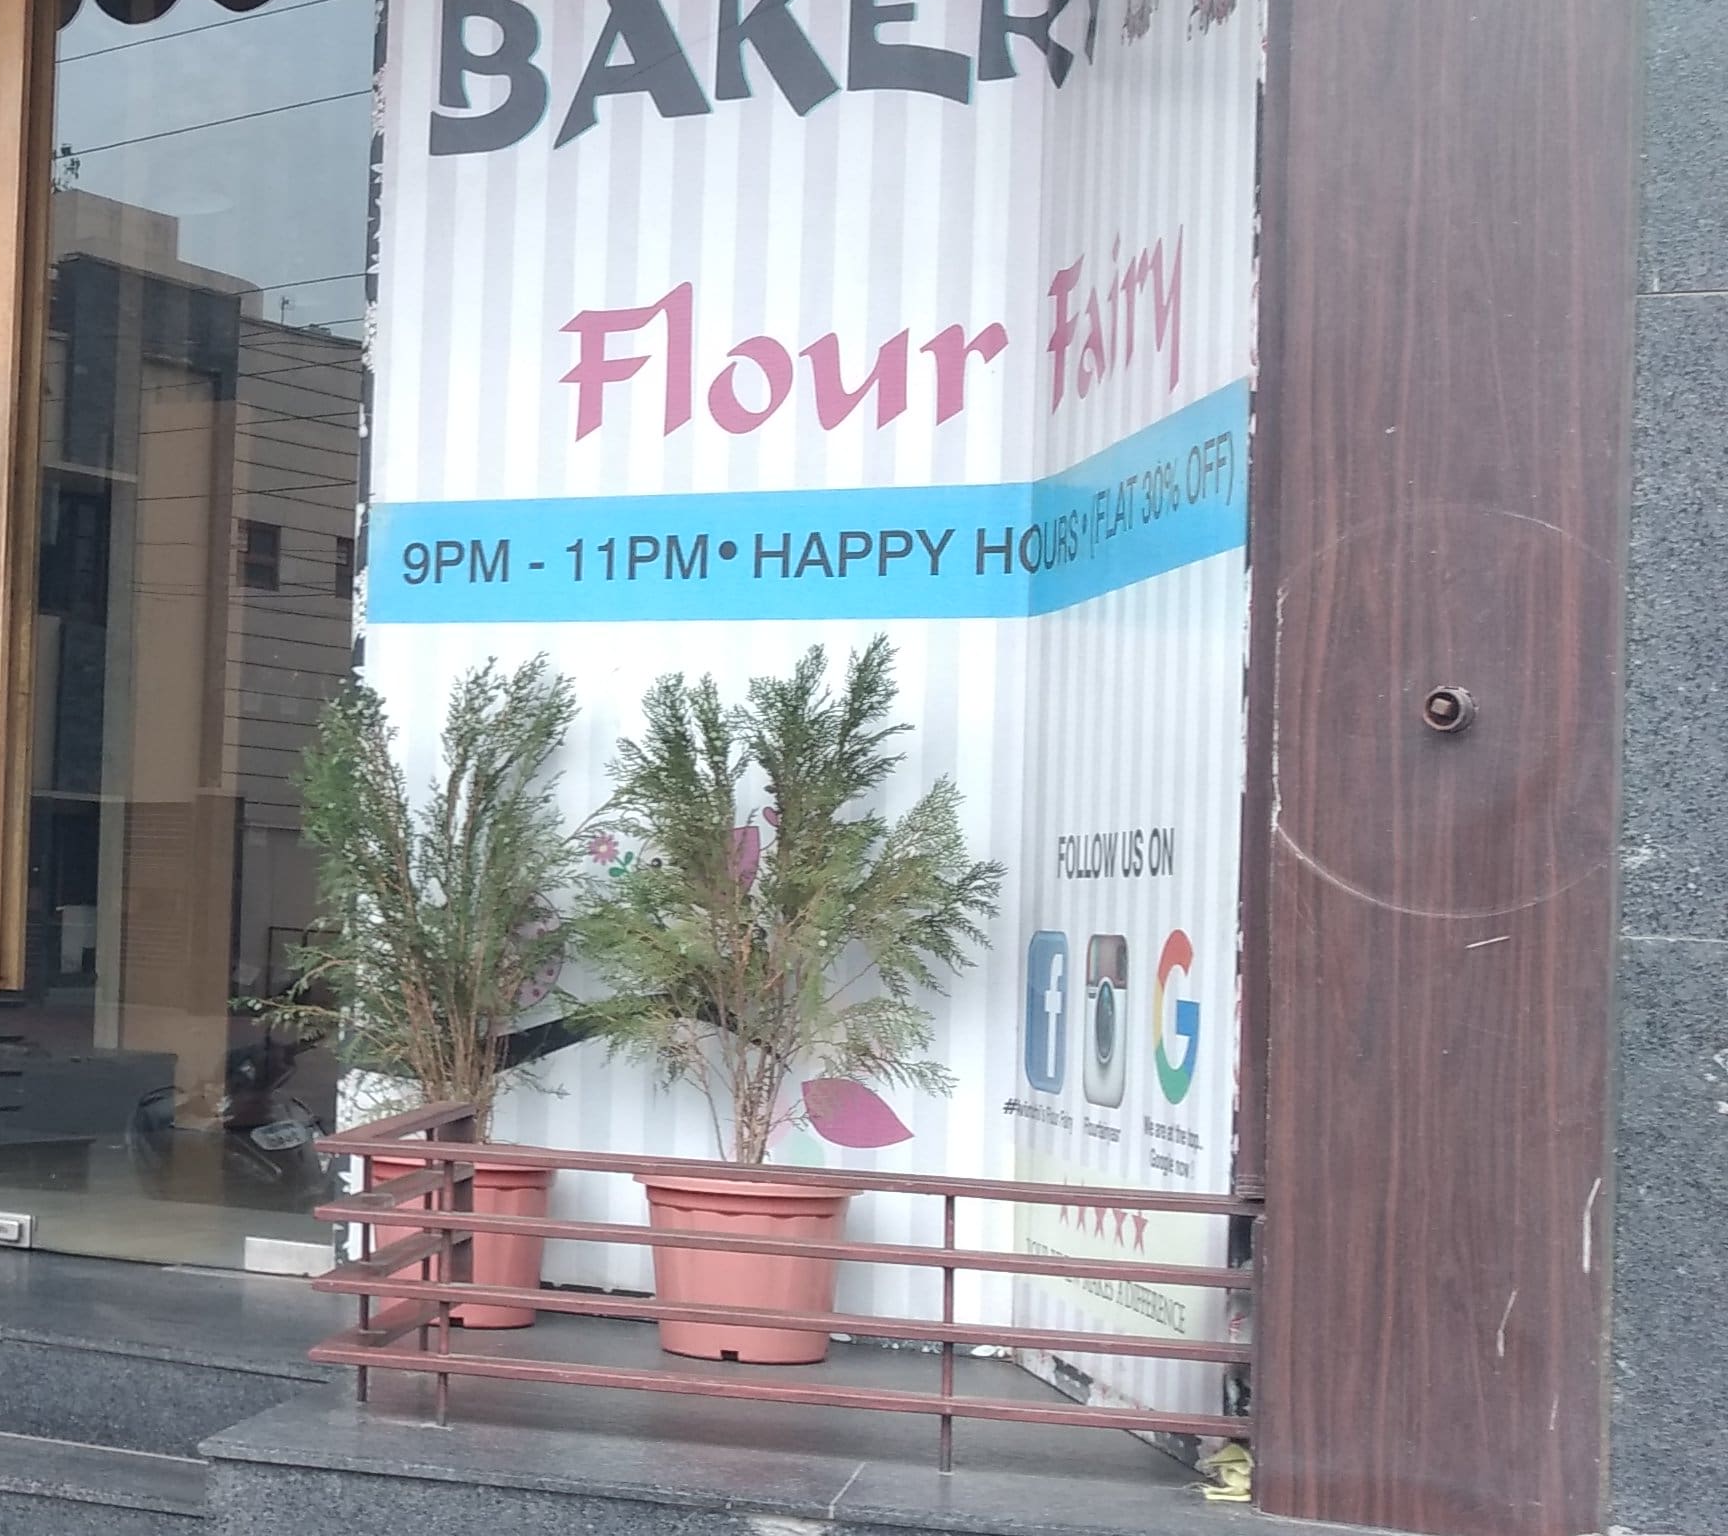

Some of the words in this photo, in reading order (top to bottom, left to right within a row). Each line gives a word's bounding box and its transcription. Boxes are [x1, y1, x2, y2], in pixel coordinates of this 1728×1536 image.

[559, 281, 1010, 441] Flour
[1047, 223, 1184, 415] Fairy
[402, 539, 510, 585] 9PM
[565, 533, 709, 582] 11PM
[752, 528, 956, 579] HAPPY
[975, 509, 1078, 574] HOURS
[1140, 459, 1181, 525] 30%
[1185, 430, 1234, 506] OFF)
[1057, 832, 1119, 879] FOLLOW
[1121, 828, 1144, 877] US
[1148, 827, 1174, 876] ON
